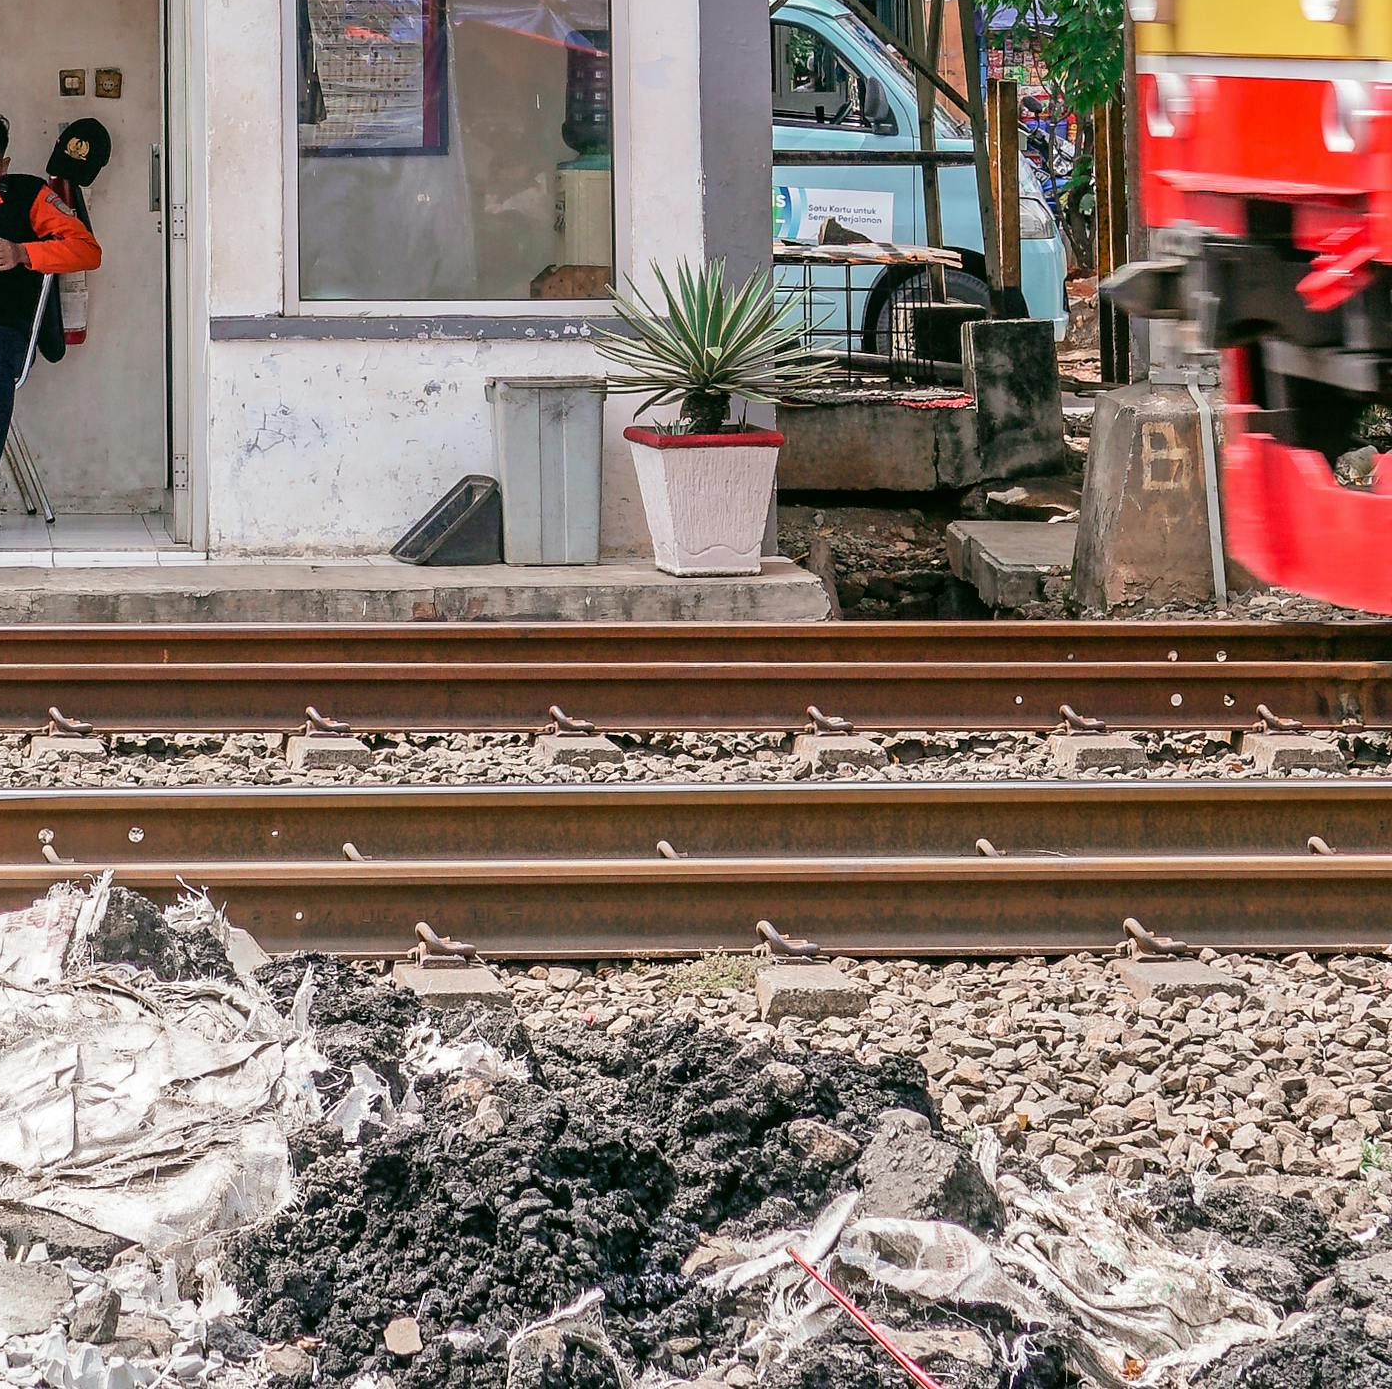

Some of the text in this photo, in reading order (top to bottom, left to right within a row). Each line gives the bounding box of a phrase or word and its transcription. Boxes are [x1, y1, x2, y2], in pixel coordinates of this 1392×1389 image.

[808, 204, 877, 215] Satu Kartu untuk
[838, 214, 882, 224] Perjalanan
